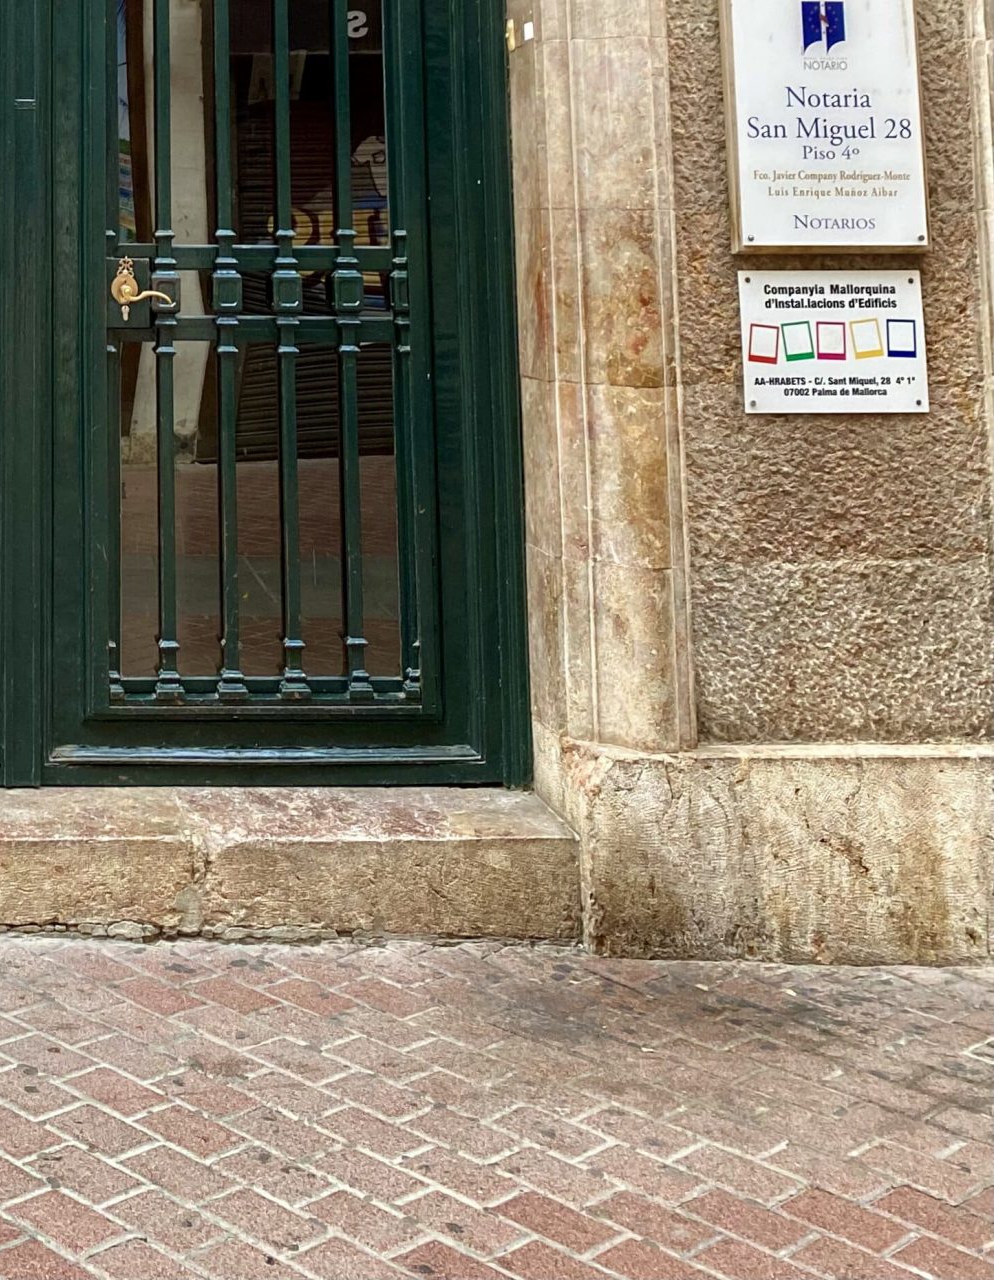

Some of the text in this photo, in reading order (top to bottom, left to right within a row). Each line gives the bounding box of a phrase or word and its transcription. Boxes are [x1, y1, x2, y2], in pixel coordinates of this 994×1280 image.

[803, 60, 848, 71] NOTARIO
[785, 86, 872, 109] Notaria
[746, 116, 912, 147] San Miguel 28
[802, 144, 836, 161] Piso
[753, 170, 771, 181] Fco.
[772, 170, 796, 182] Javier
[798, 170, 838, 183] Company
[768, 185, 898, 200] Luis Enrique Muñoz Aibar
[793, 214, 876, 231] NOTARIOS
[763, 284, 896, 297] Companyia Mallorquina
[848, 297, 897, 309] d'Edificis
[828, 377, 847, 385] Sant
[880, 377, 891, 385] 28
[784, 388, 887, 396] 07002 Palma de Mallorca
